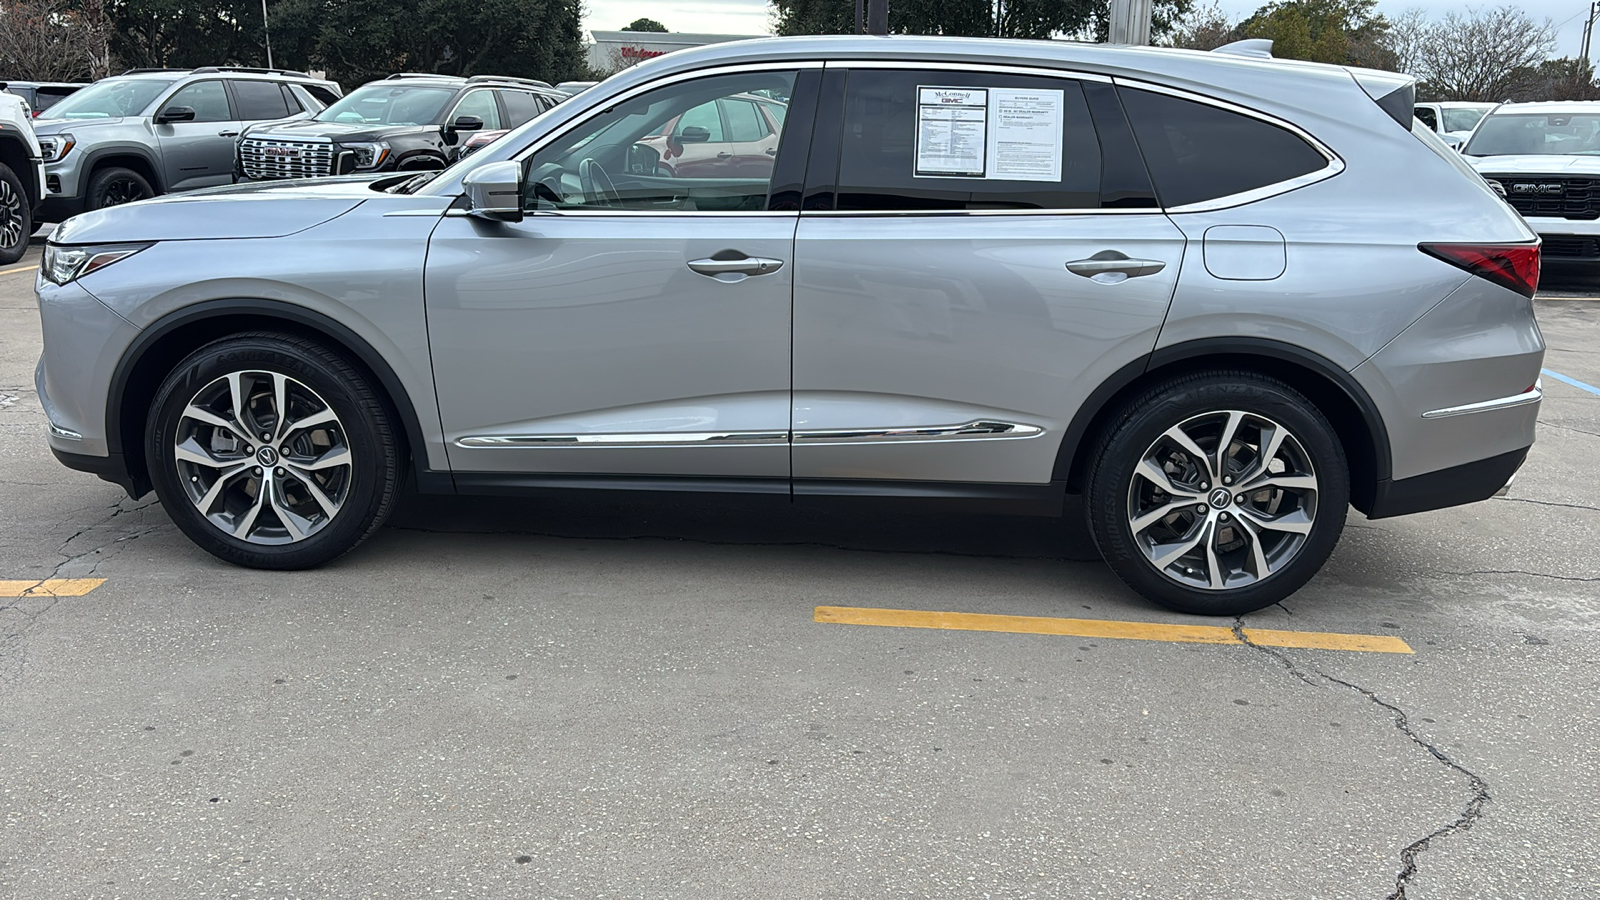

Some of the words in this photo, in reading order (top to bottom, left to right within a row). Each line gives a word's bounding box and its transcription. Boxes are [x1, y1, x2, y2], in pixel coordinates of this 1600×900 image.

[621, 47, 670, 58] Walgree
[934, 91, 971, 99] McConnell
[265, 147, 298, 156] GMC
[1513, 183, 1561, 193] GMC
